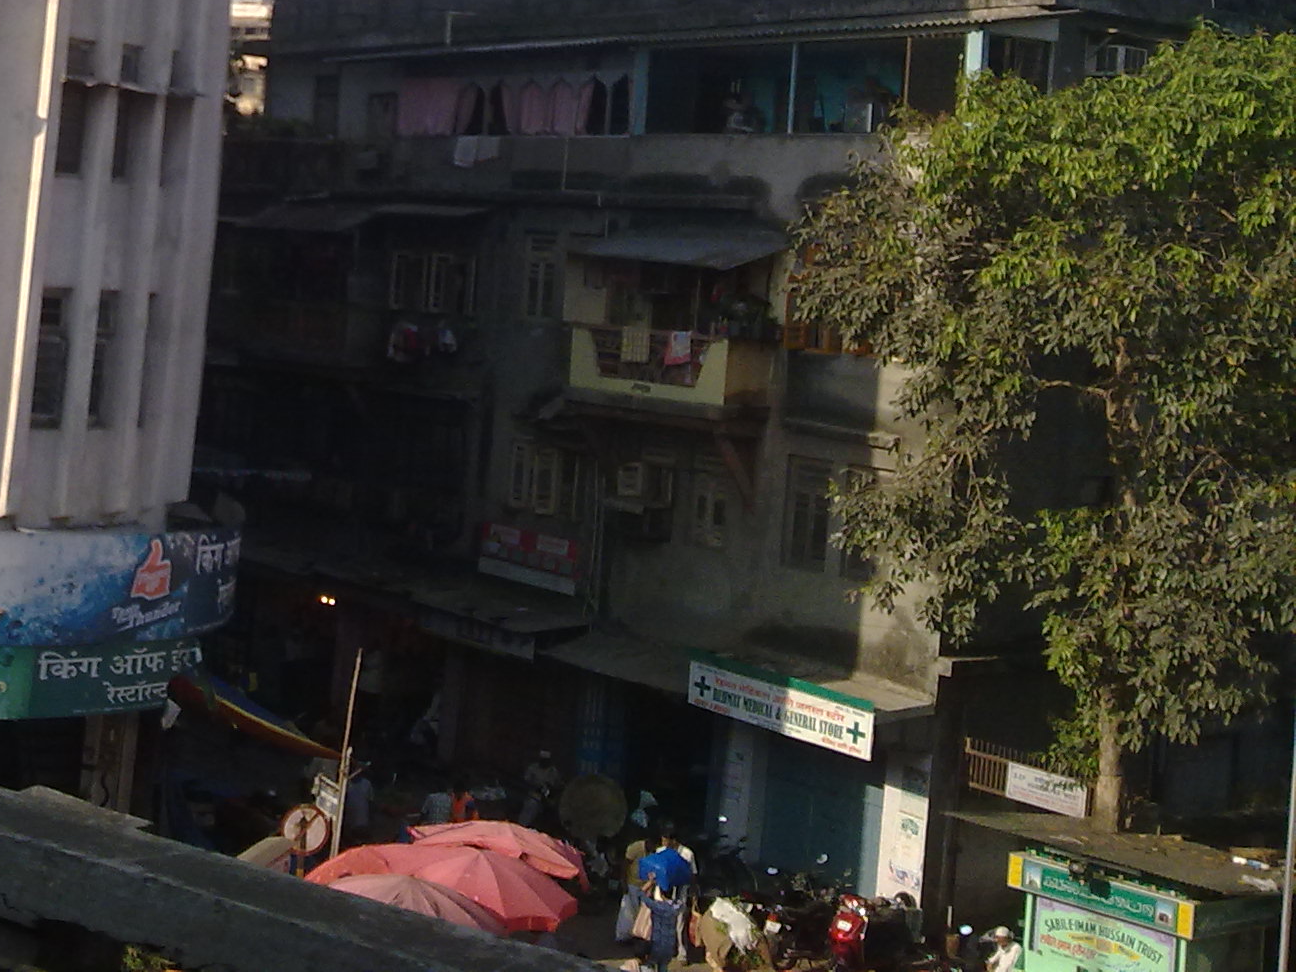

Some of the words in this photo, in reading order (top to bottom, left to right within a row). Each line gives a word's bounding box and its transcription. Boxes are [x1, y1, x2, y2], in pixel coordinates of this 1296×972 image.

[38, 651, 102, 680] किंग
[109, 648, 166, 675] ऑफ
[819, 719, 844, 740] STORE
[1137, 939, 1163, 965] TRUST
